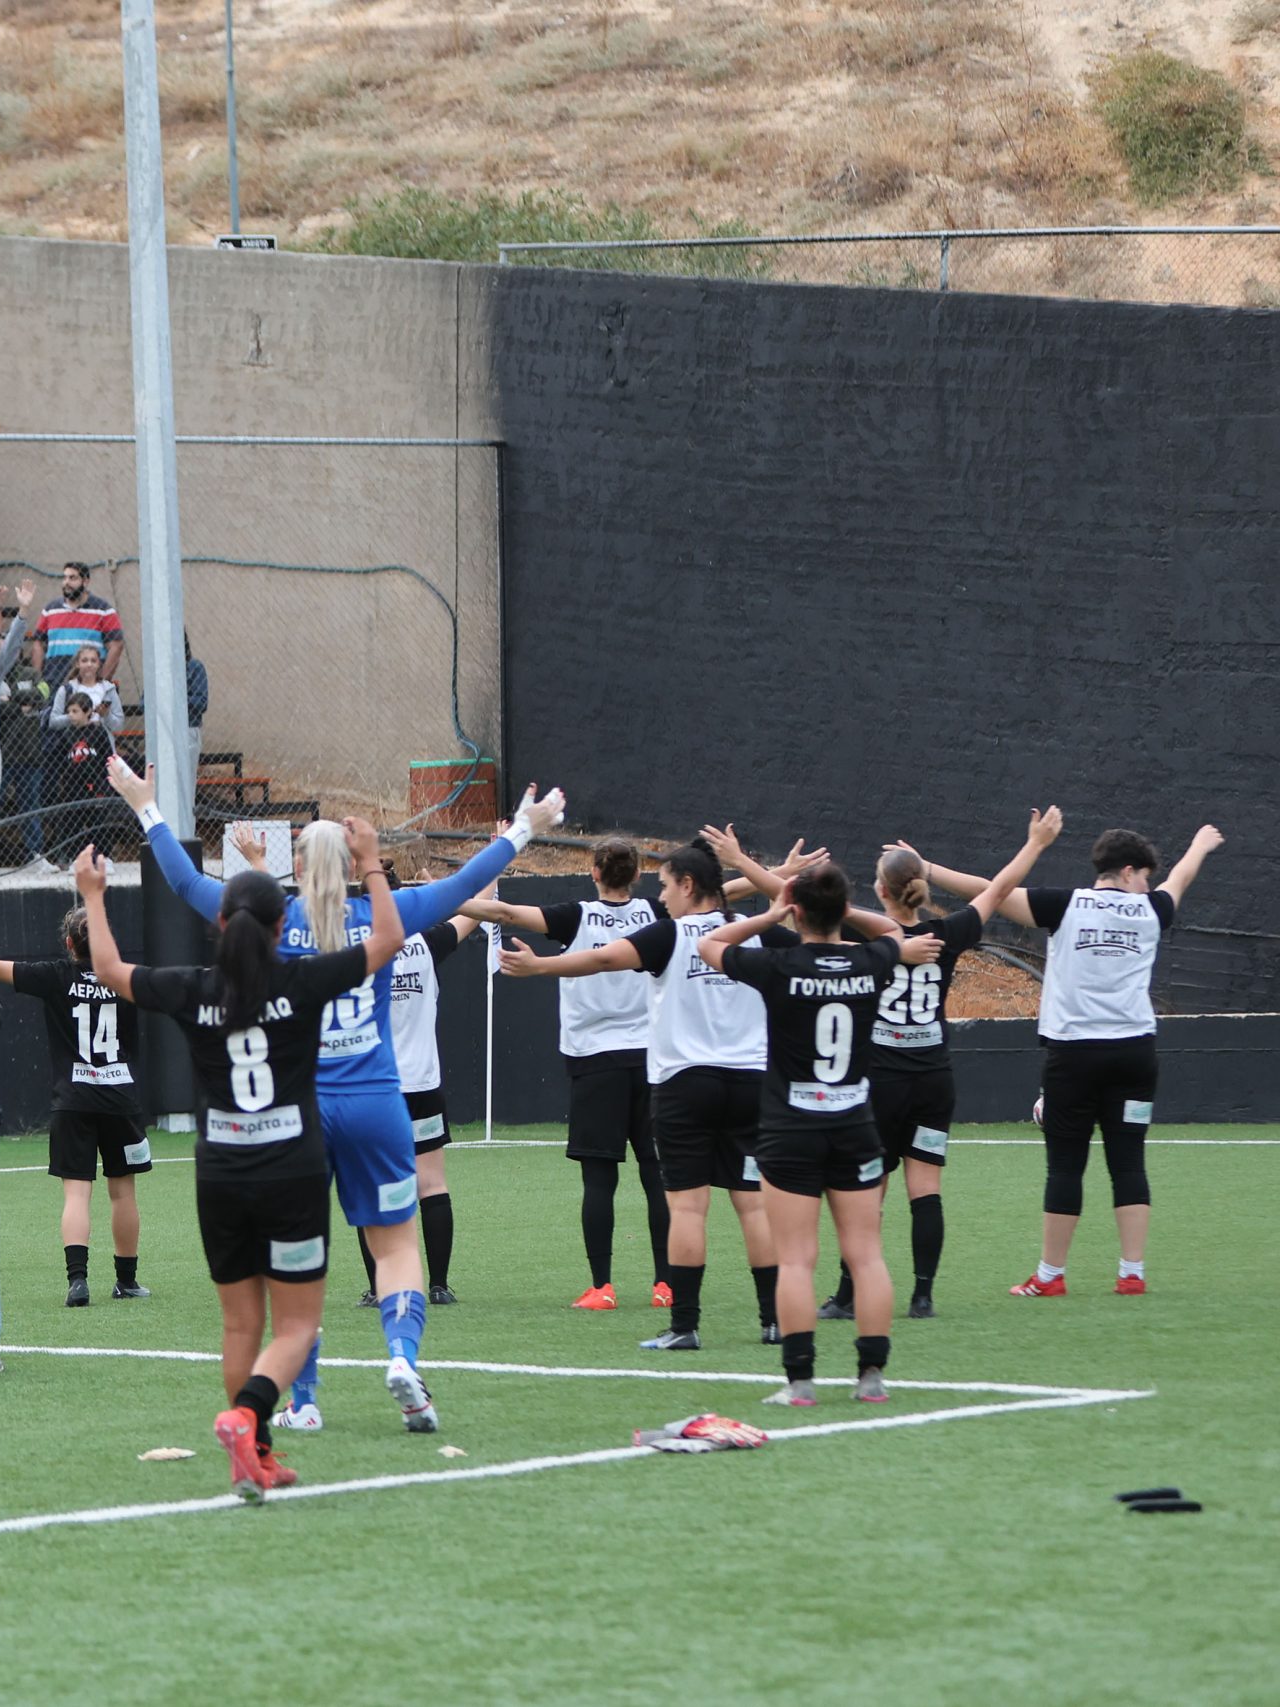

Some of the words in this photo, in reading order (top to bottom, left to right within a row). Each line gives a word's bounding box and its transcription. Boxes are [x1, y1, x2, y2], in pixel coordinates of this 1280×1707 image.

[789, 975, 875, 996] ΓΟΥΝΑΚΗ
[878, 963, 942, 1025] 26
[72, 1002, 120, 1064] 14
[813, 1003, 854, 1084] 9
[226, 1026, 275, 1113] 8
